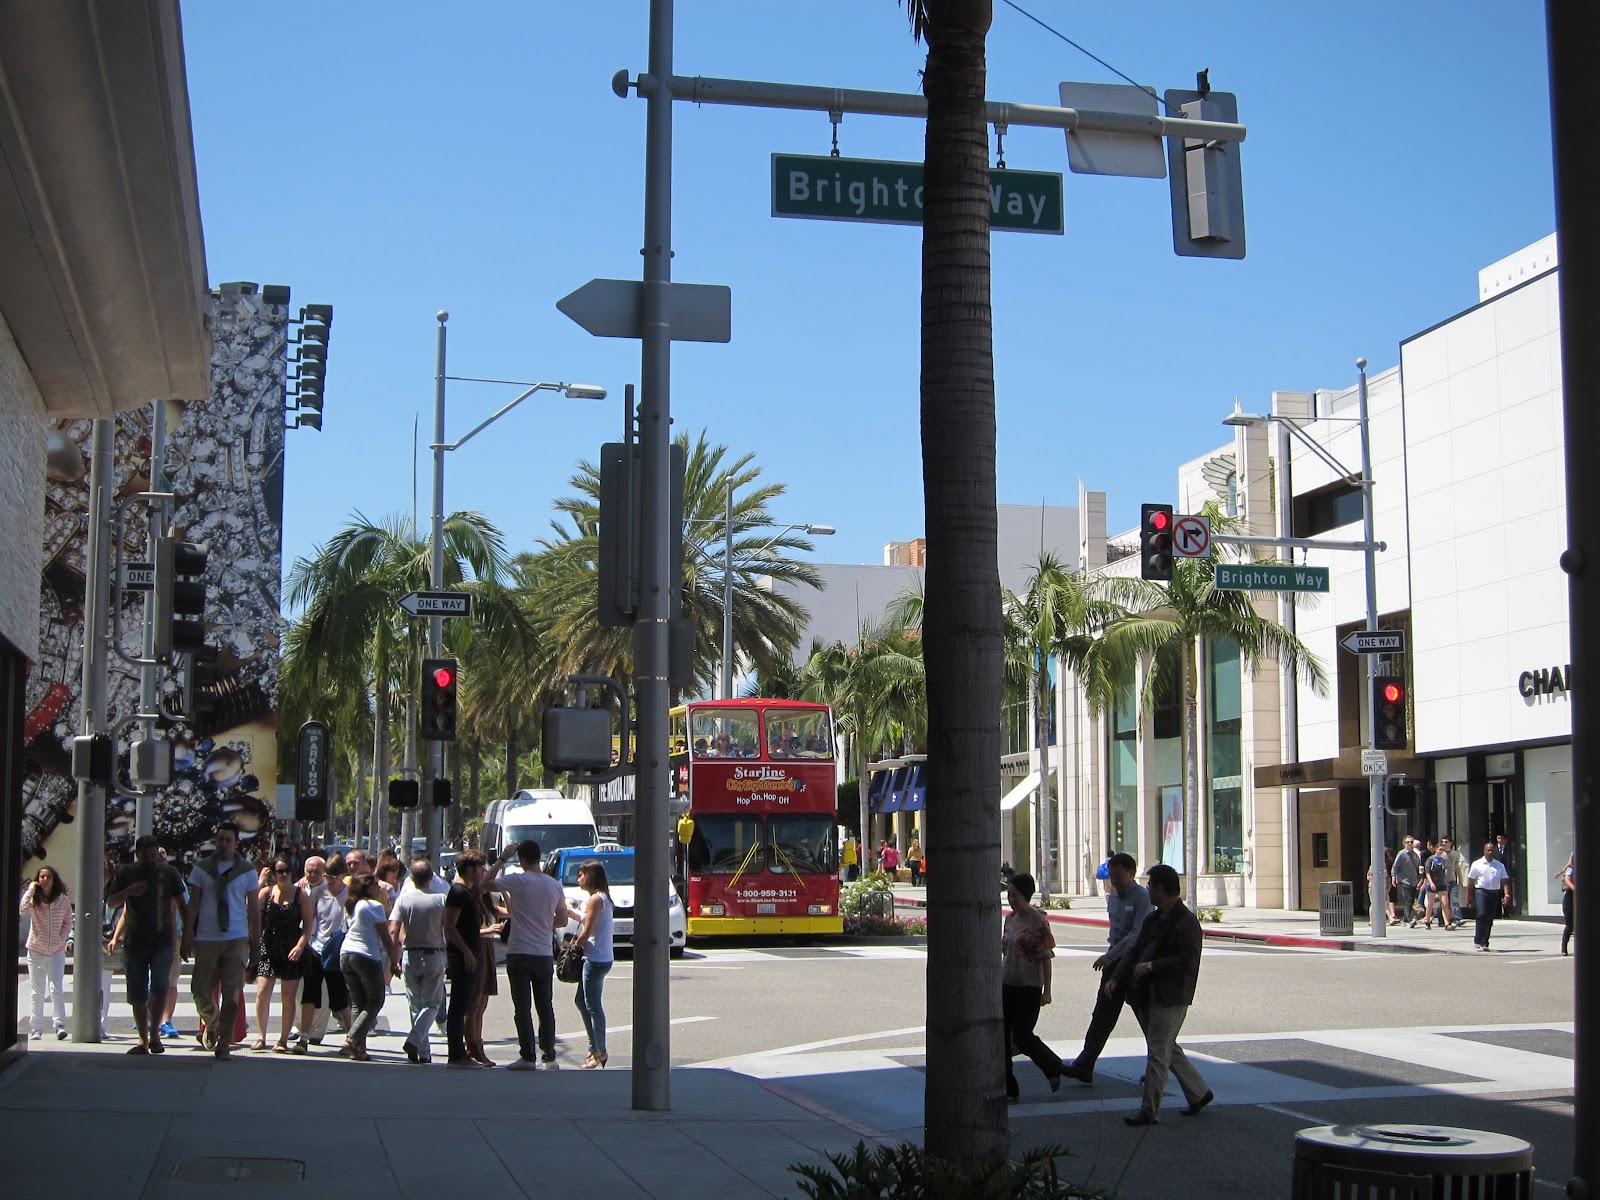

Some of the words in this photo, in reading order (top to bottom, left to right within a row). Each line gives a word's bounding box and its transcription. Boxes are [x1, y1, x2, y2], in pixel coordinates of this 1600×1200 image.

[789, 170, 925, 216] Brighto
[129, 571, 152, 582] ONE
[1221, 570, 1287, 588] Brighton
[1295, 572, 1323, 589] Way
[418, 599, 438, 609] ONE
[441, 600, 462, 609] WAY
[1358, 638, 1376, 647] ONE
[1378, 638, 1397, 646] WAY
[308, 735, 318, 787] PARKING
[733, 766, 787, 781] StarLine
[1363, 763, 1374, 773] OK
[736, 796, 751, 805] Hop
[763, 792, 777, 801] Hop
[778, 796, 790, 805] Off
[736, 889, 797, 898] 1-800-959-3131
